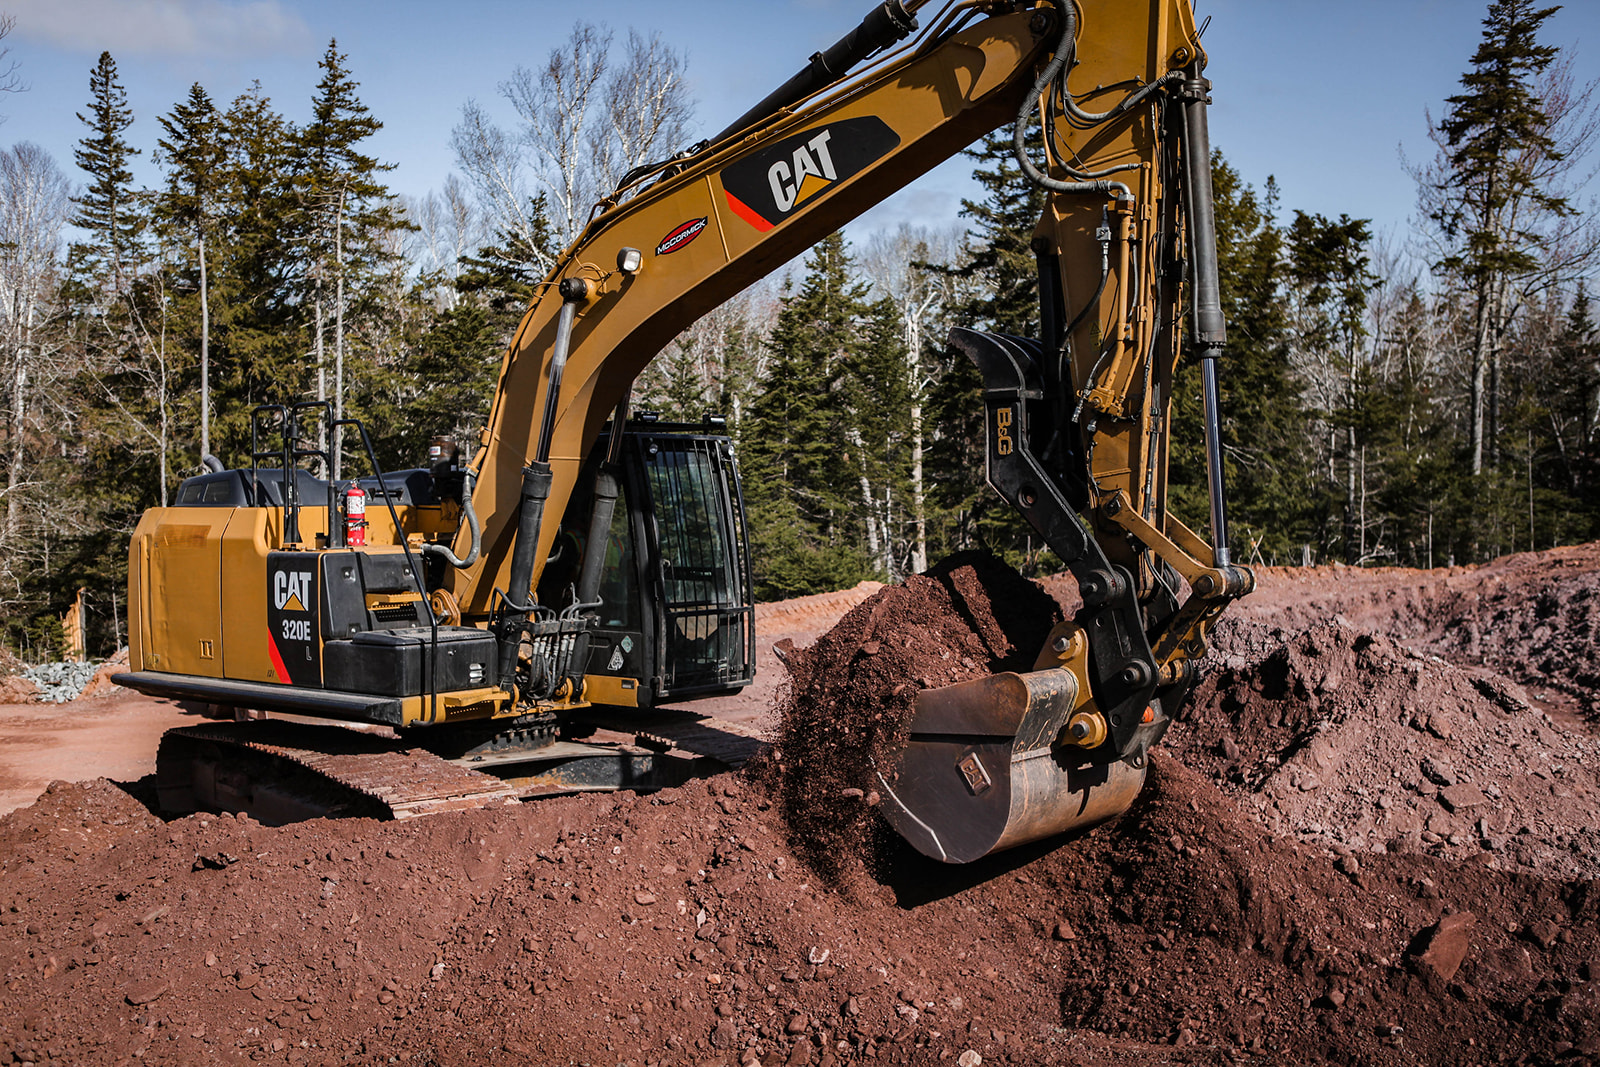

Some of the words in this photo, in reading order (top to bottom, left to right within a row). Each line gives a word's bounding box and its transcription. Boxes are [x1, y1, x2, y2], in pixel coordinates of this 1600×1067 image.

[768, 128, 838, 213] CAT
[656, 218, 706, 255] MCCORMICK
[997, 407, 1012, 455] B&G
[274, 570, 312, 612] CAT
[282, 619, 311, 641] 320E
[305, 645, 312, 660] L
